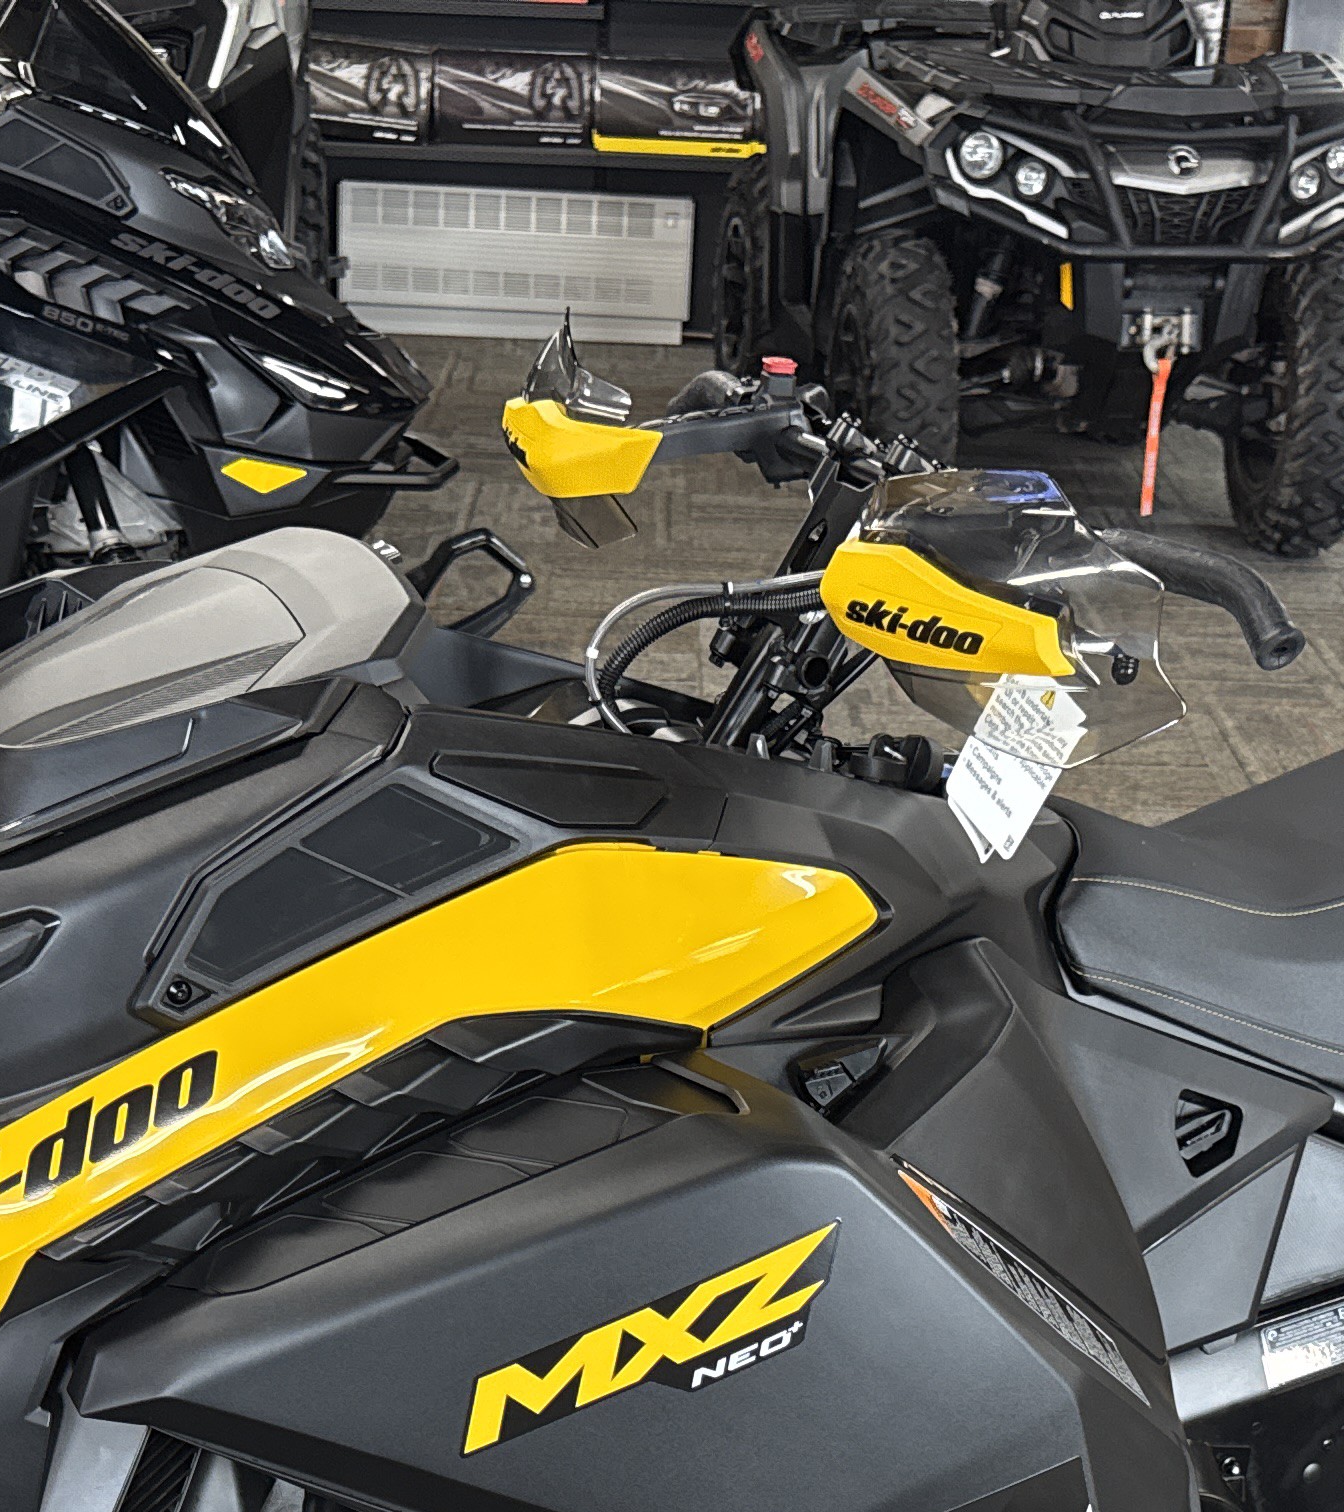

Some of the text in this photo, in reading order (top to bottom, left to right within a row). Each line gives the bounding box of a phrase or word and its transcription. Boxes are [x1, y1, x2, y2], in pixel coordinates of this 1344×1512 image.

[109, 232, 283, 320] ski-doo
[42, 304, 95, 334] 850
[845, 599, 985, 656] ski-doo
[972, 747, 1002, 785] Campaigns
[464, 1222, 839, 1455] MXZ
